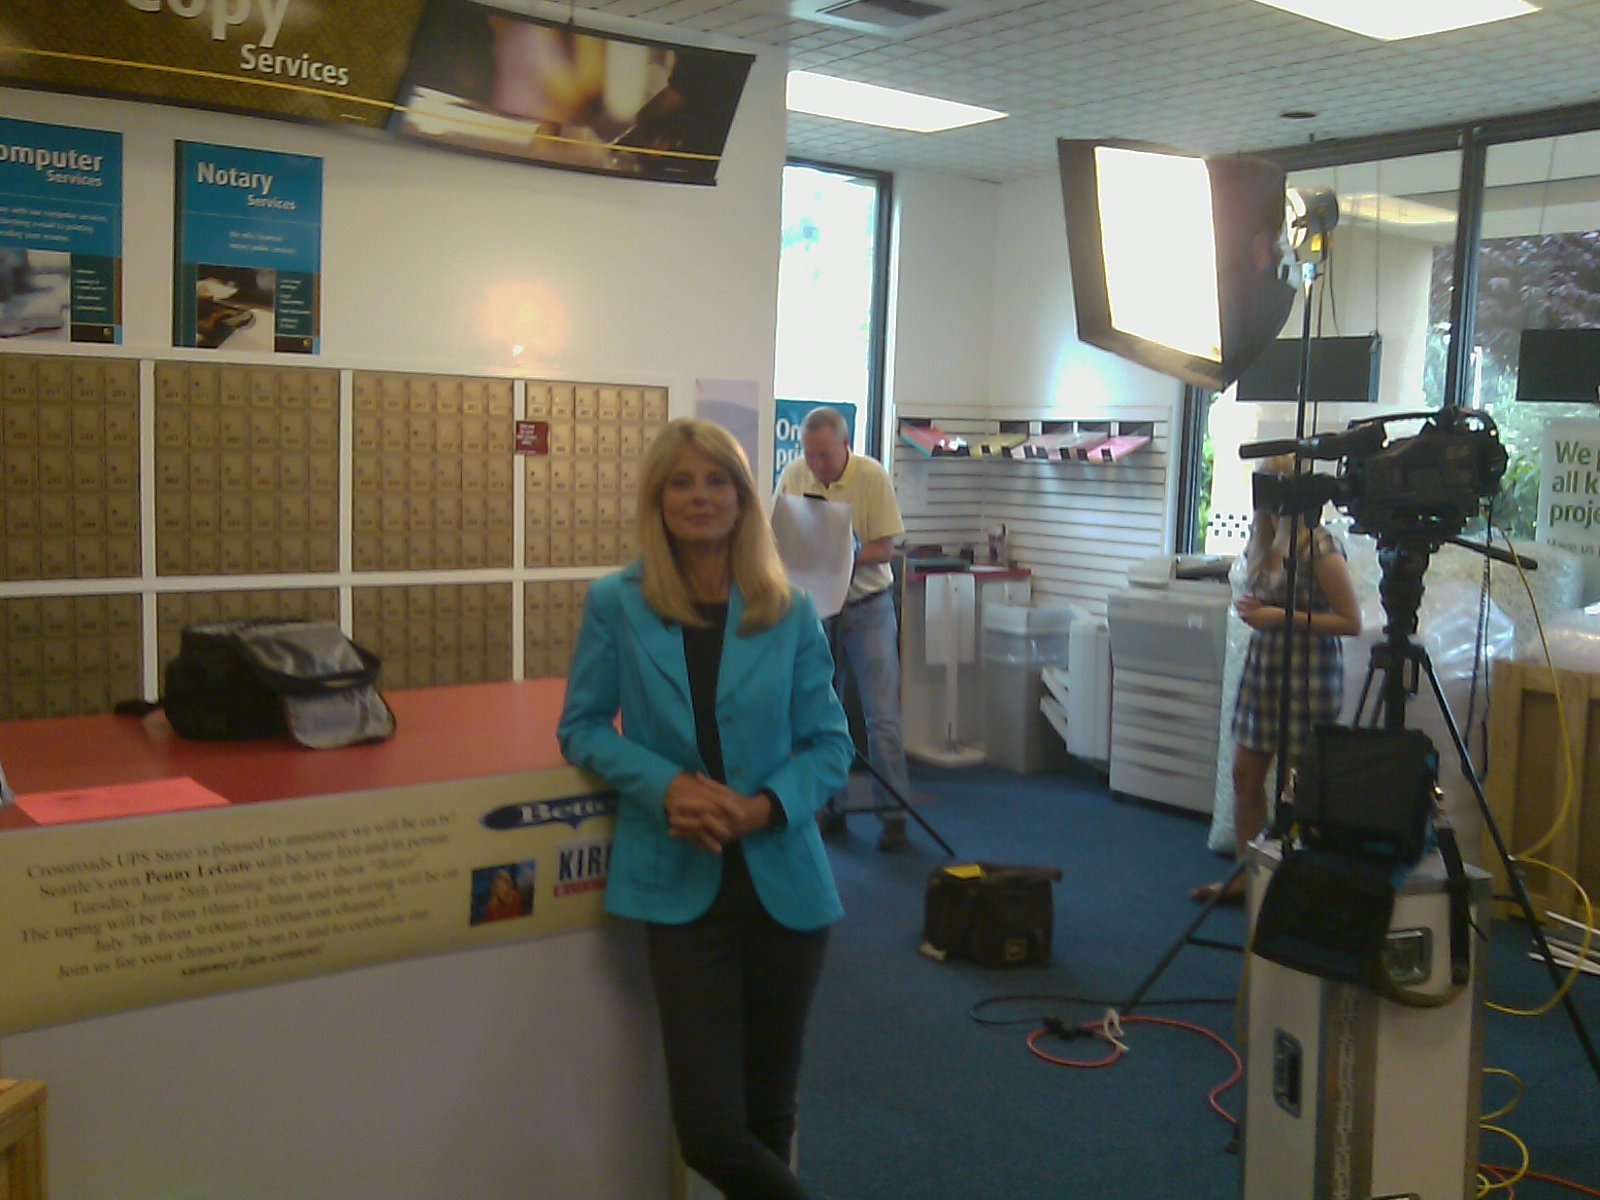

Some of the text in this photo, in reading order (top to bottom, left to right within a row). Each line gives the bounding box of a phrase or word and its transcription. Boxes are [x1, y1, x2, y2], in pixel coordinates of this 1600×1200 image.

[127, 0, 289, 48] opy
[240, 43, 349, 86] Services
[46, 169, 103, 188] Services
[197, 161, 274, 195] Notary
[247, 194, 297, 211] Services
[1555, 439, 1591, 465] We
[1552, 469, 1578, 493] all
